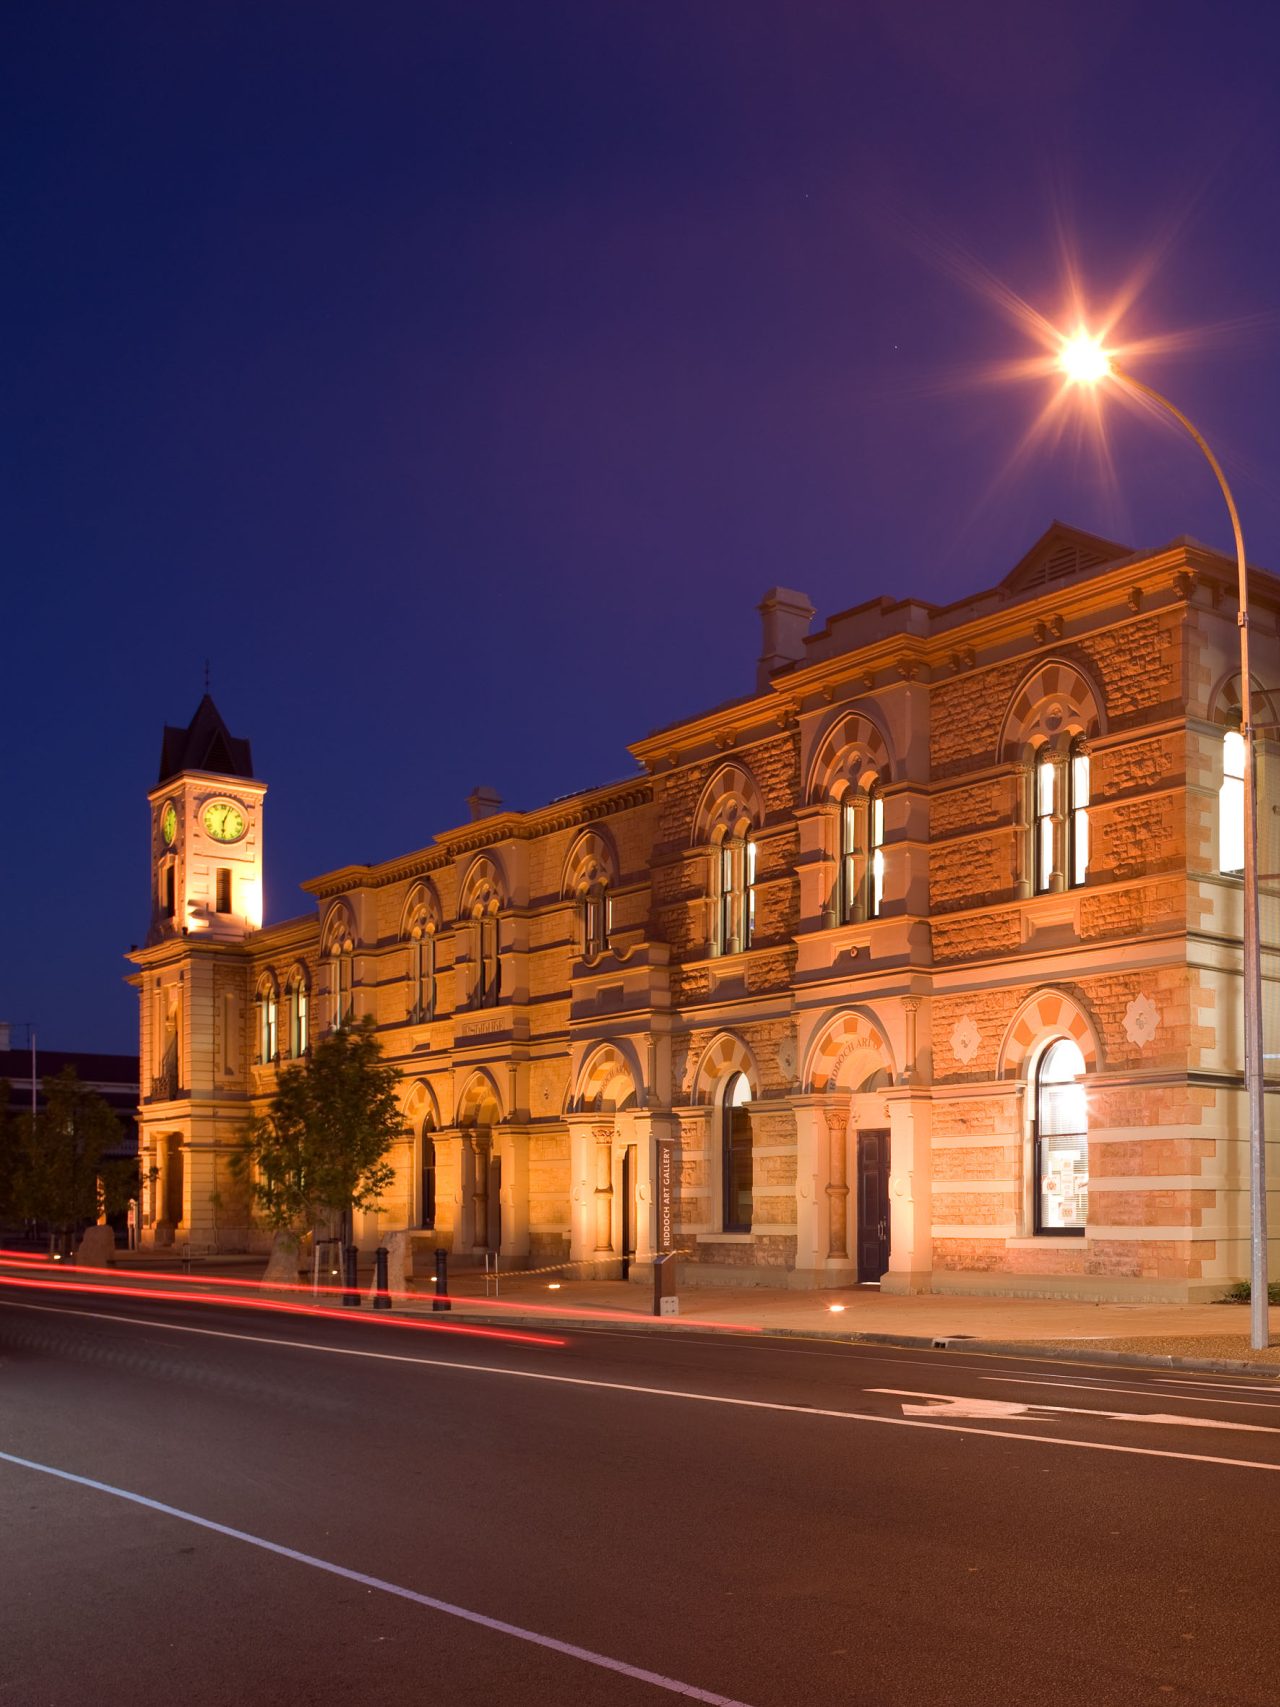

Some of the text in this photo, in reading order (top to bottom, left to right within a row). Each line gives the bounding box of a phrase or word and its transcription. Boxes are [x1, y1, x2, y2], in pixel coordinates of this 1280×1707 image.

[663, 1148, 671, 1246] RIDDOCH ART GALLERY
